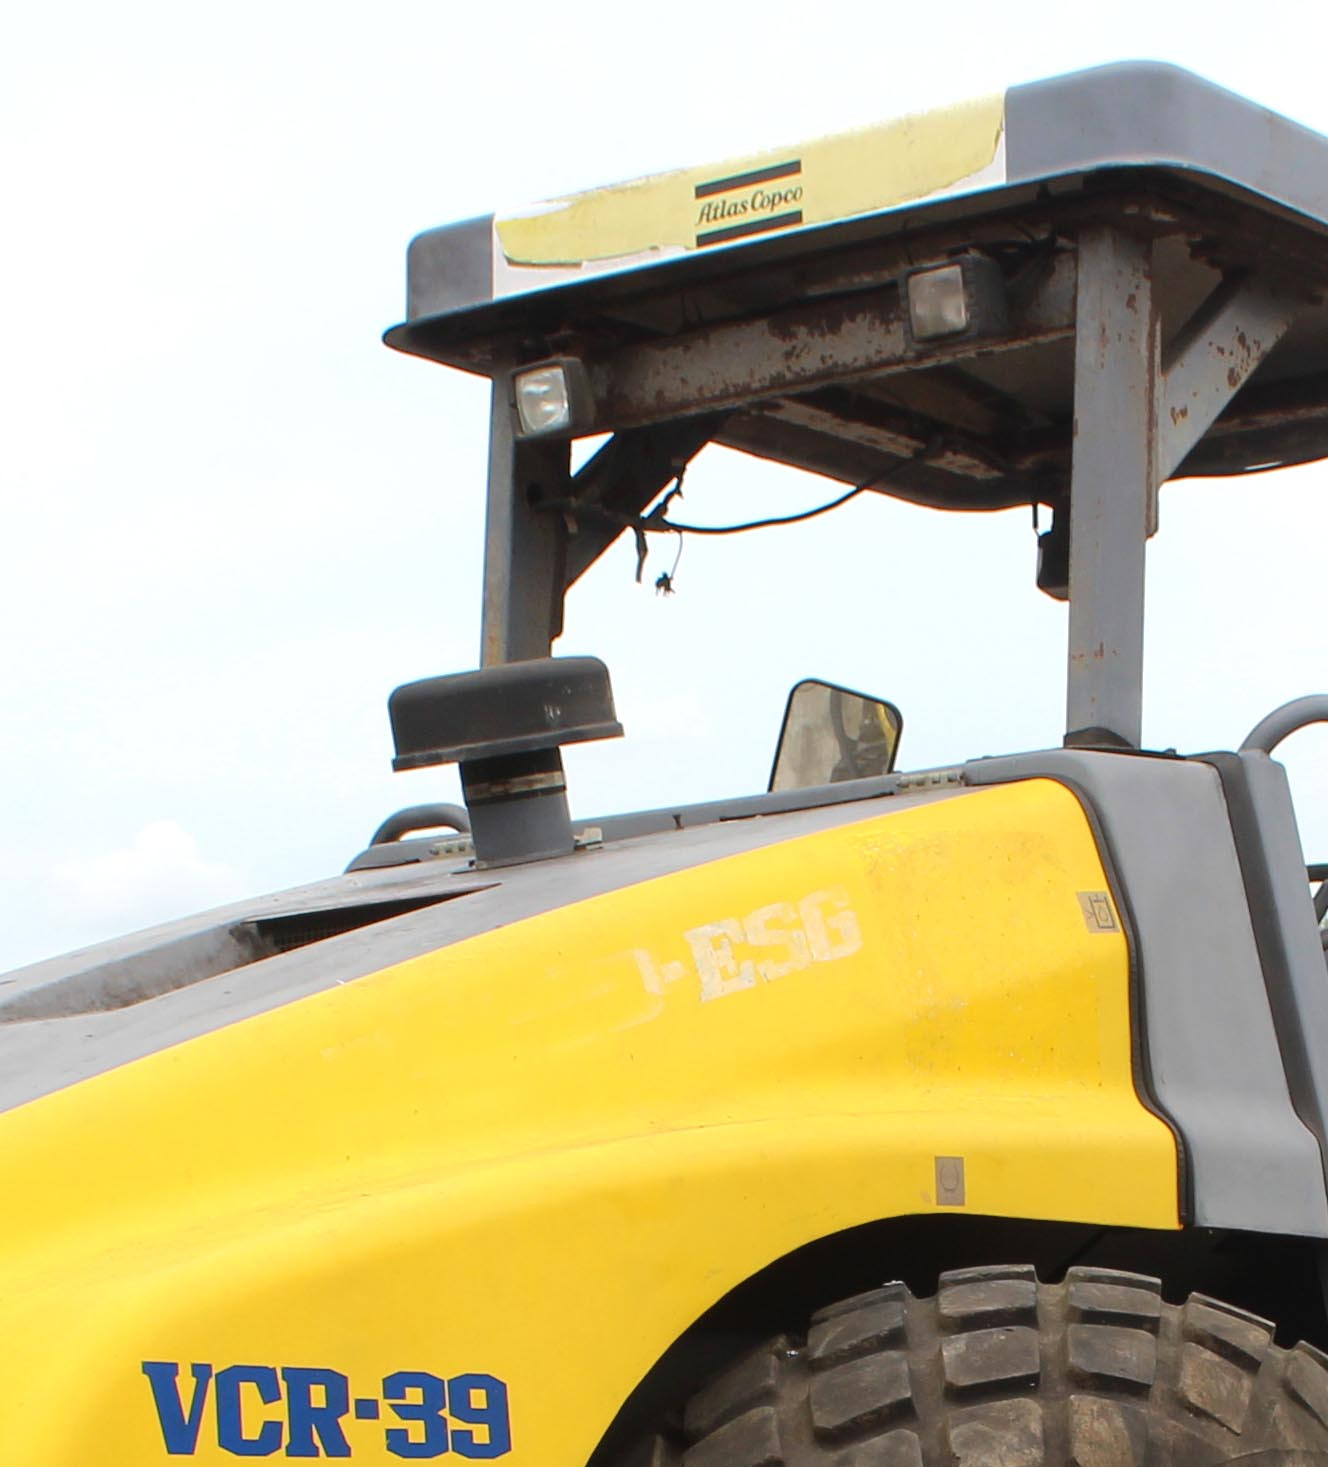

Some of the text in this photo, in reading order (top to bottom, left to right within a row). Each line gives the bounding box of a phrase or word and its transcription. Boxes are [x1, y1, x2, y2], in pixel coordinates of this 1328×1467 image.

[695, 187, 804, 225] Atlas Copco
[141, 1361, 512, 1459] VCR-39
